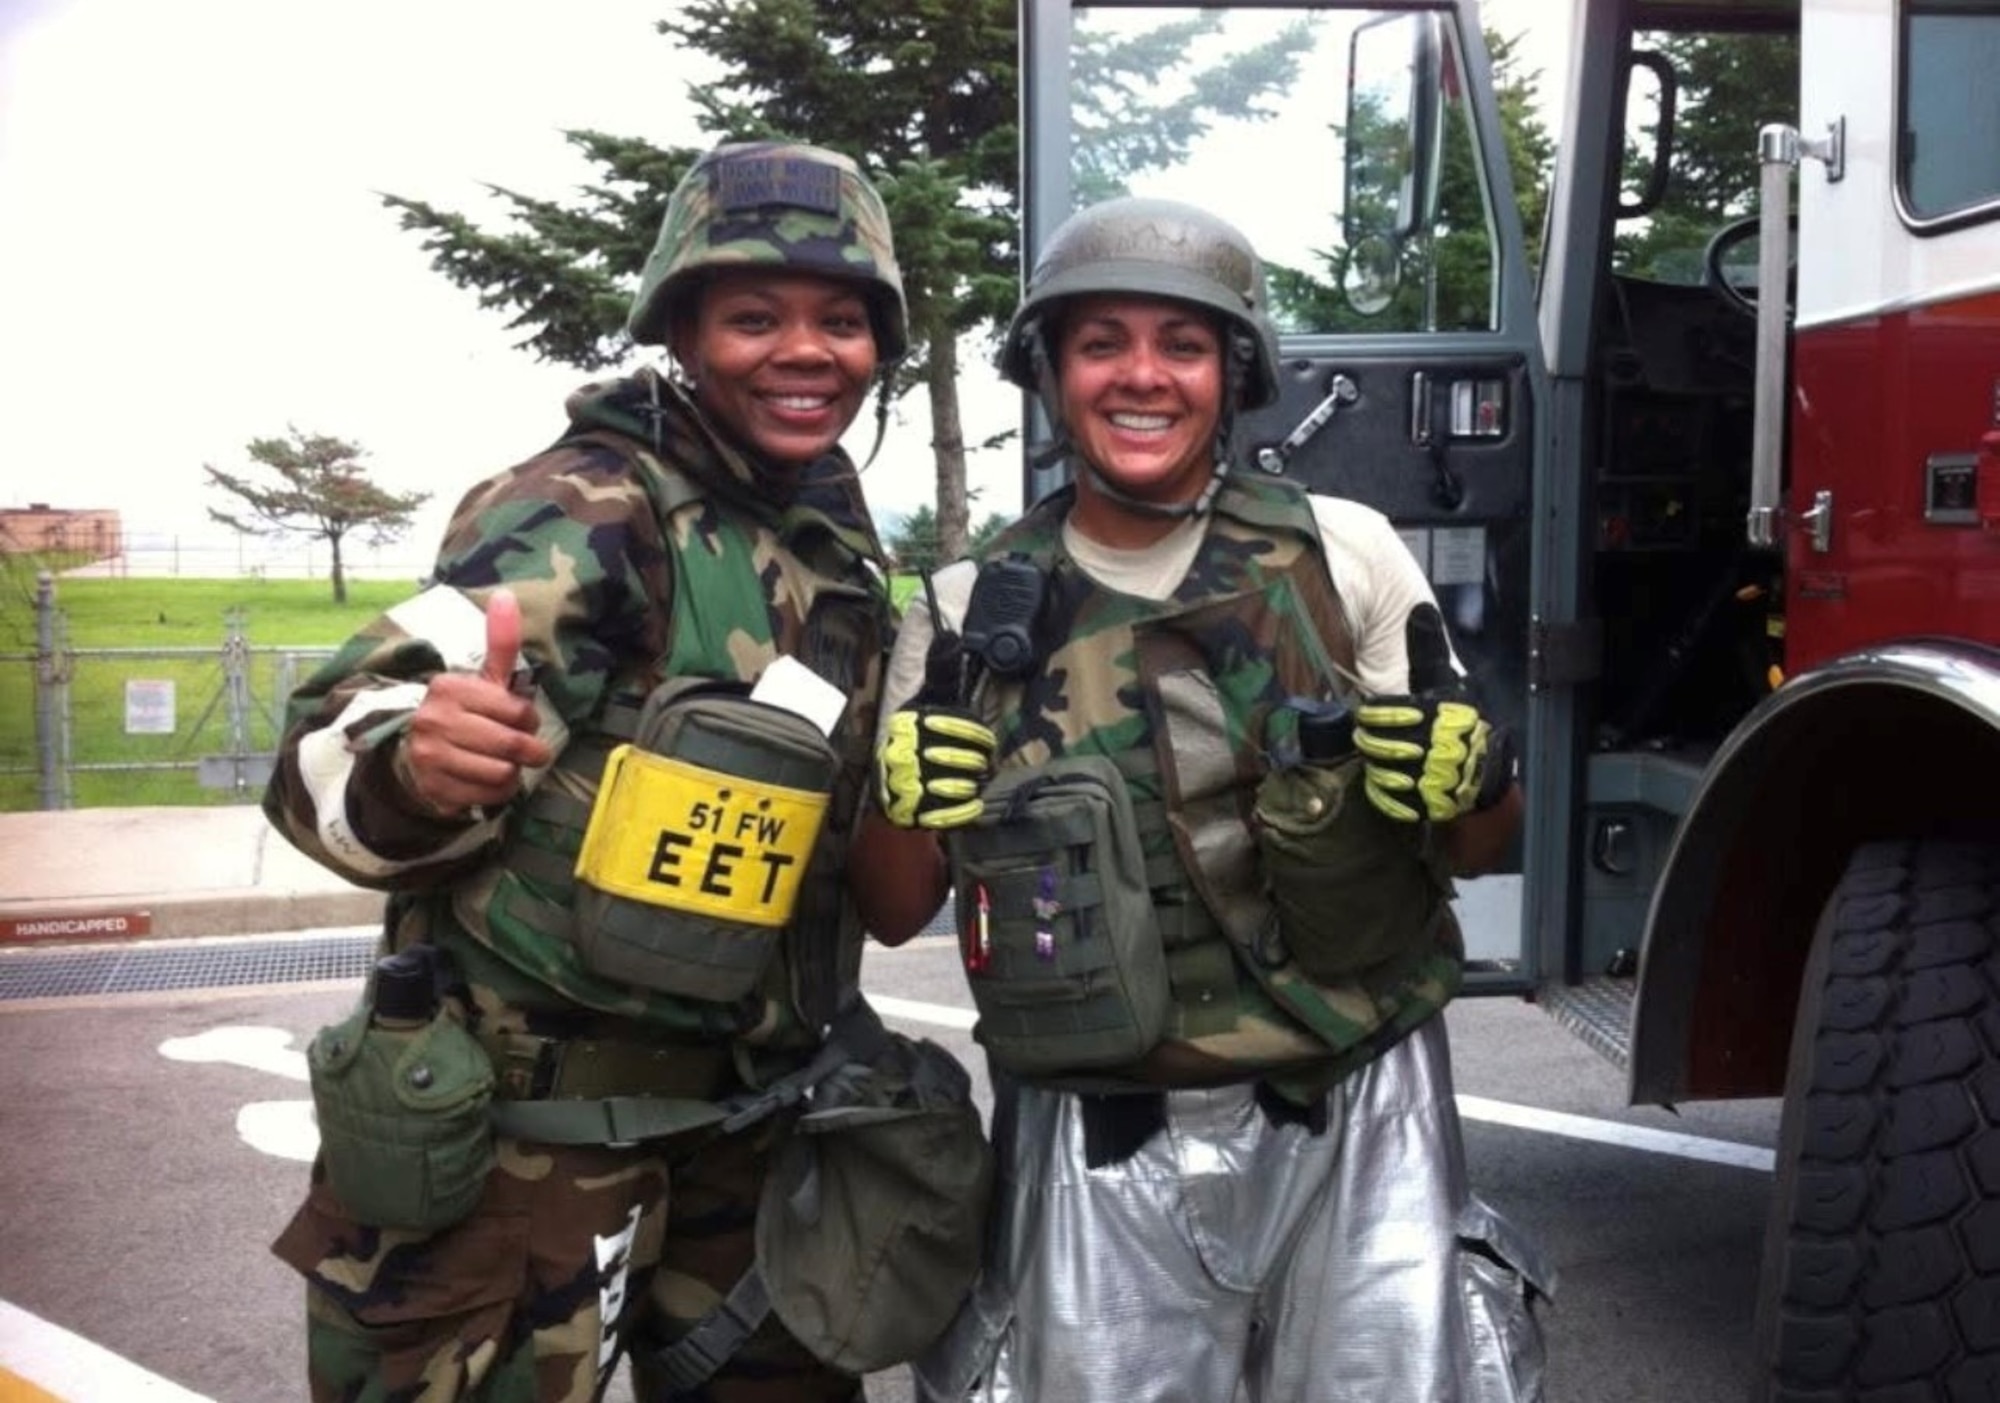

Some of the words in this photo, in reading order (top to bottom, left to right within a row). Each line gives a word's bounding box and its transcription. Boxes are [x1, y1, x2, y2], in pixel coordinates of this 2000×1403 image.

[688, 802, 724, 834] 51
[735, 813, 786, 846] FW
[647, 829, 795, 904] EET
[16, 917, 128, 936] HANDICAPPED
